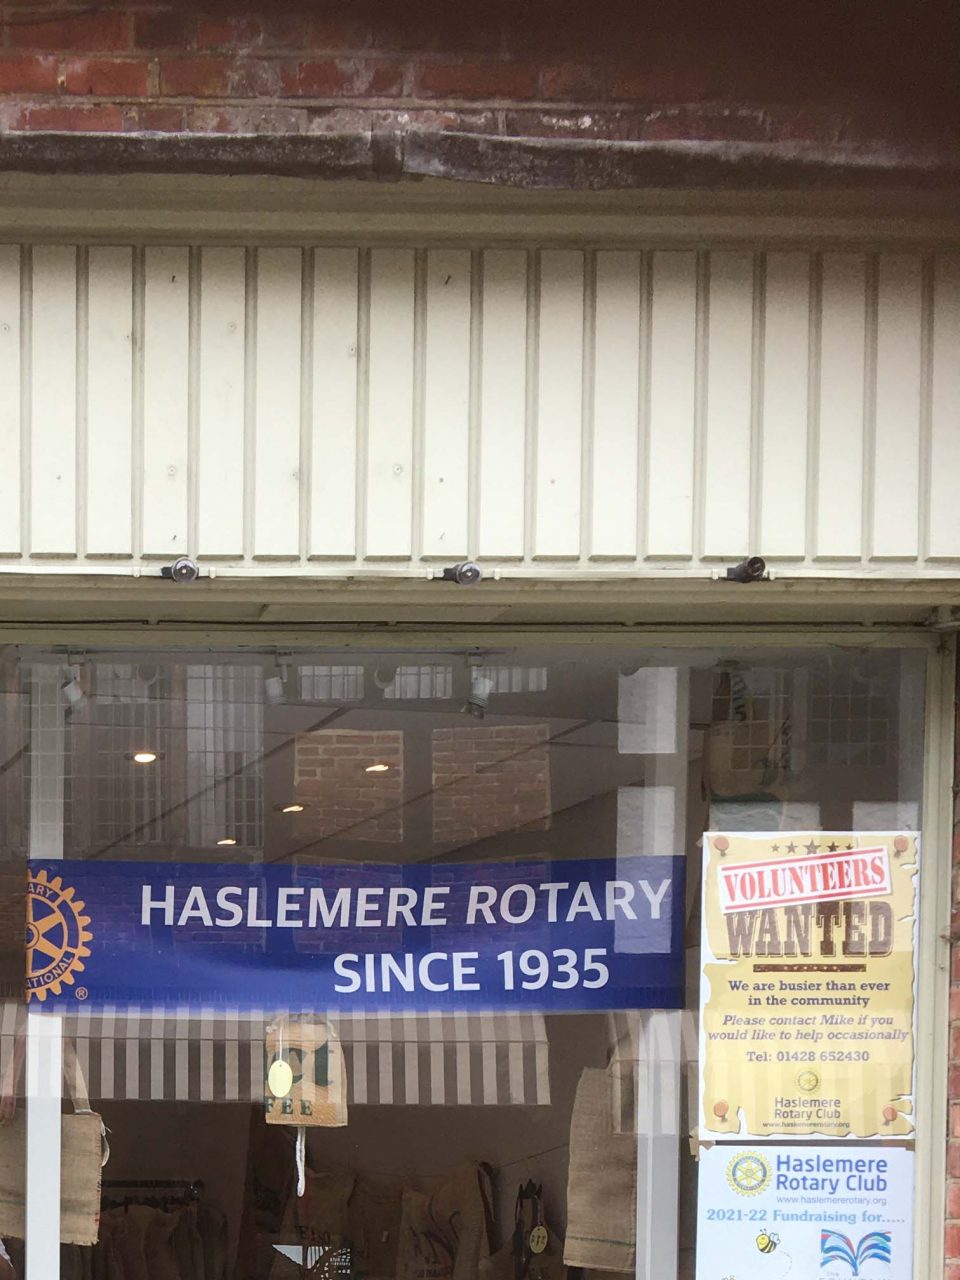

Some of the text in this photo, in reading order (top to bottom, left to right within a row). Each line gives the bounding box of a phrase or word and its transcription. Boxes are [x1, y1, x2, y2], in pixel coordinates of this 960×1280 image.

[724, 855, 885, 903] VOLUNTEERS
[142, 878, 672, 928] HASLEMERE ROTARY
[724, 901, 894, 957] WANTED
[334, 948, 609, 993] SINCE 1935
[728, 980, 890, 991] We are busier than ever
[748, 995, 870, 1009] in the community
[722, 1015, 893, 1028] Please contact Mike if you
[708, 1029, 909, 1043] would like to help occasionally
[746, 1051, 870, 1062] Tel: 01428 652430
[775, 1097, 841, 1108] Haslemere
[775, 1108, 841, 1120] Rotary Club
[776, 1154, 888, 1173] Haslemere
[776, 1174, 887, 1194] Rotary Club
[776, 1196, 887, 1206] www.haslemererotary.org
[707, 1209, 768, 1221] 2021-22
[773, 1209, 856, 1224] Fundraising
